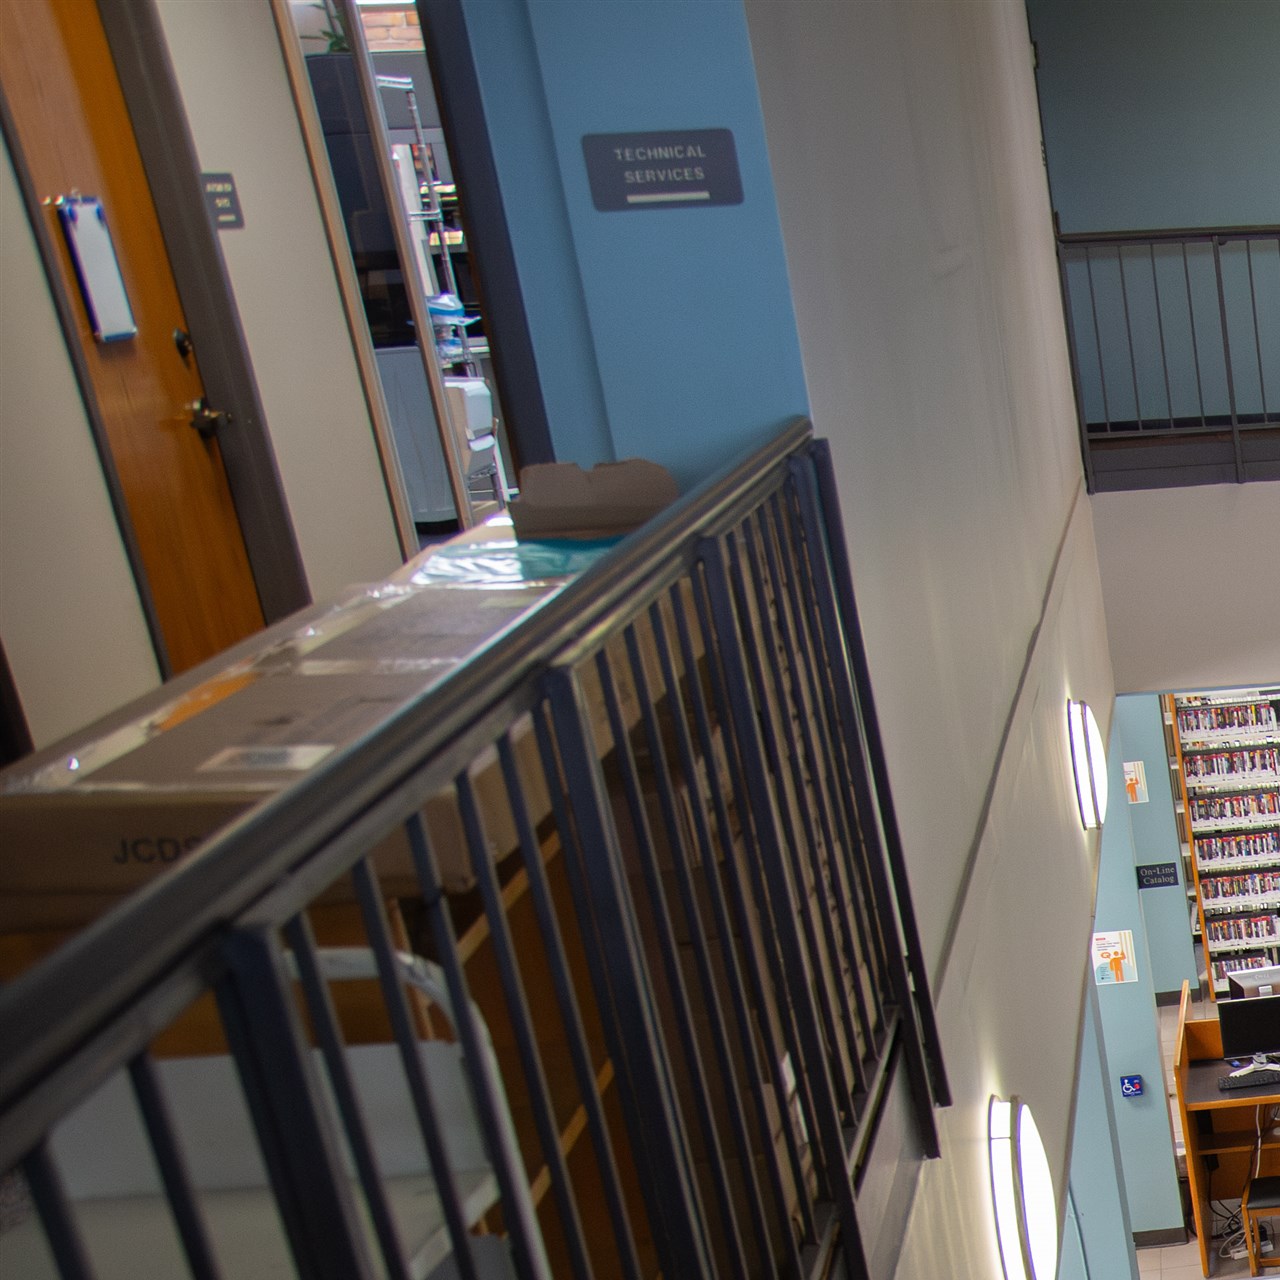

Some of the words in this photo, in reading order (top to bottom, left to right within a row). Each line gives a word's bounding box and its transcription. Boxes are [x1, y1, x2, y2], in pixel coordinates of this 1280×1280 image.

[614, 145, 706, 162] TECHNICAL
[624, 166, 705, 184] SERVICES
[1140, 866, 1175, 876] On-Line
[1143, 875, 1175, 885] Catalog
